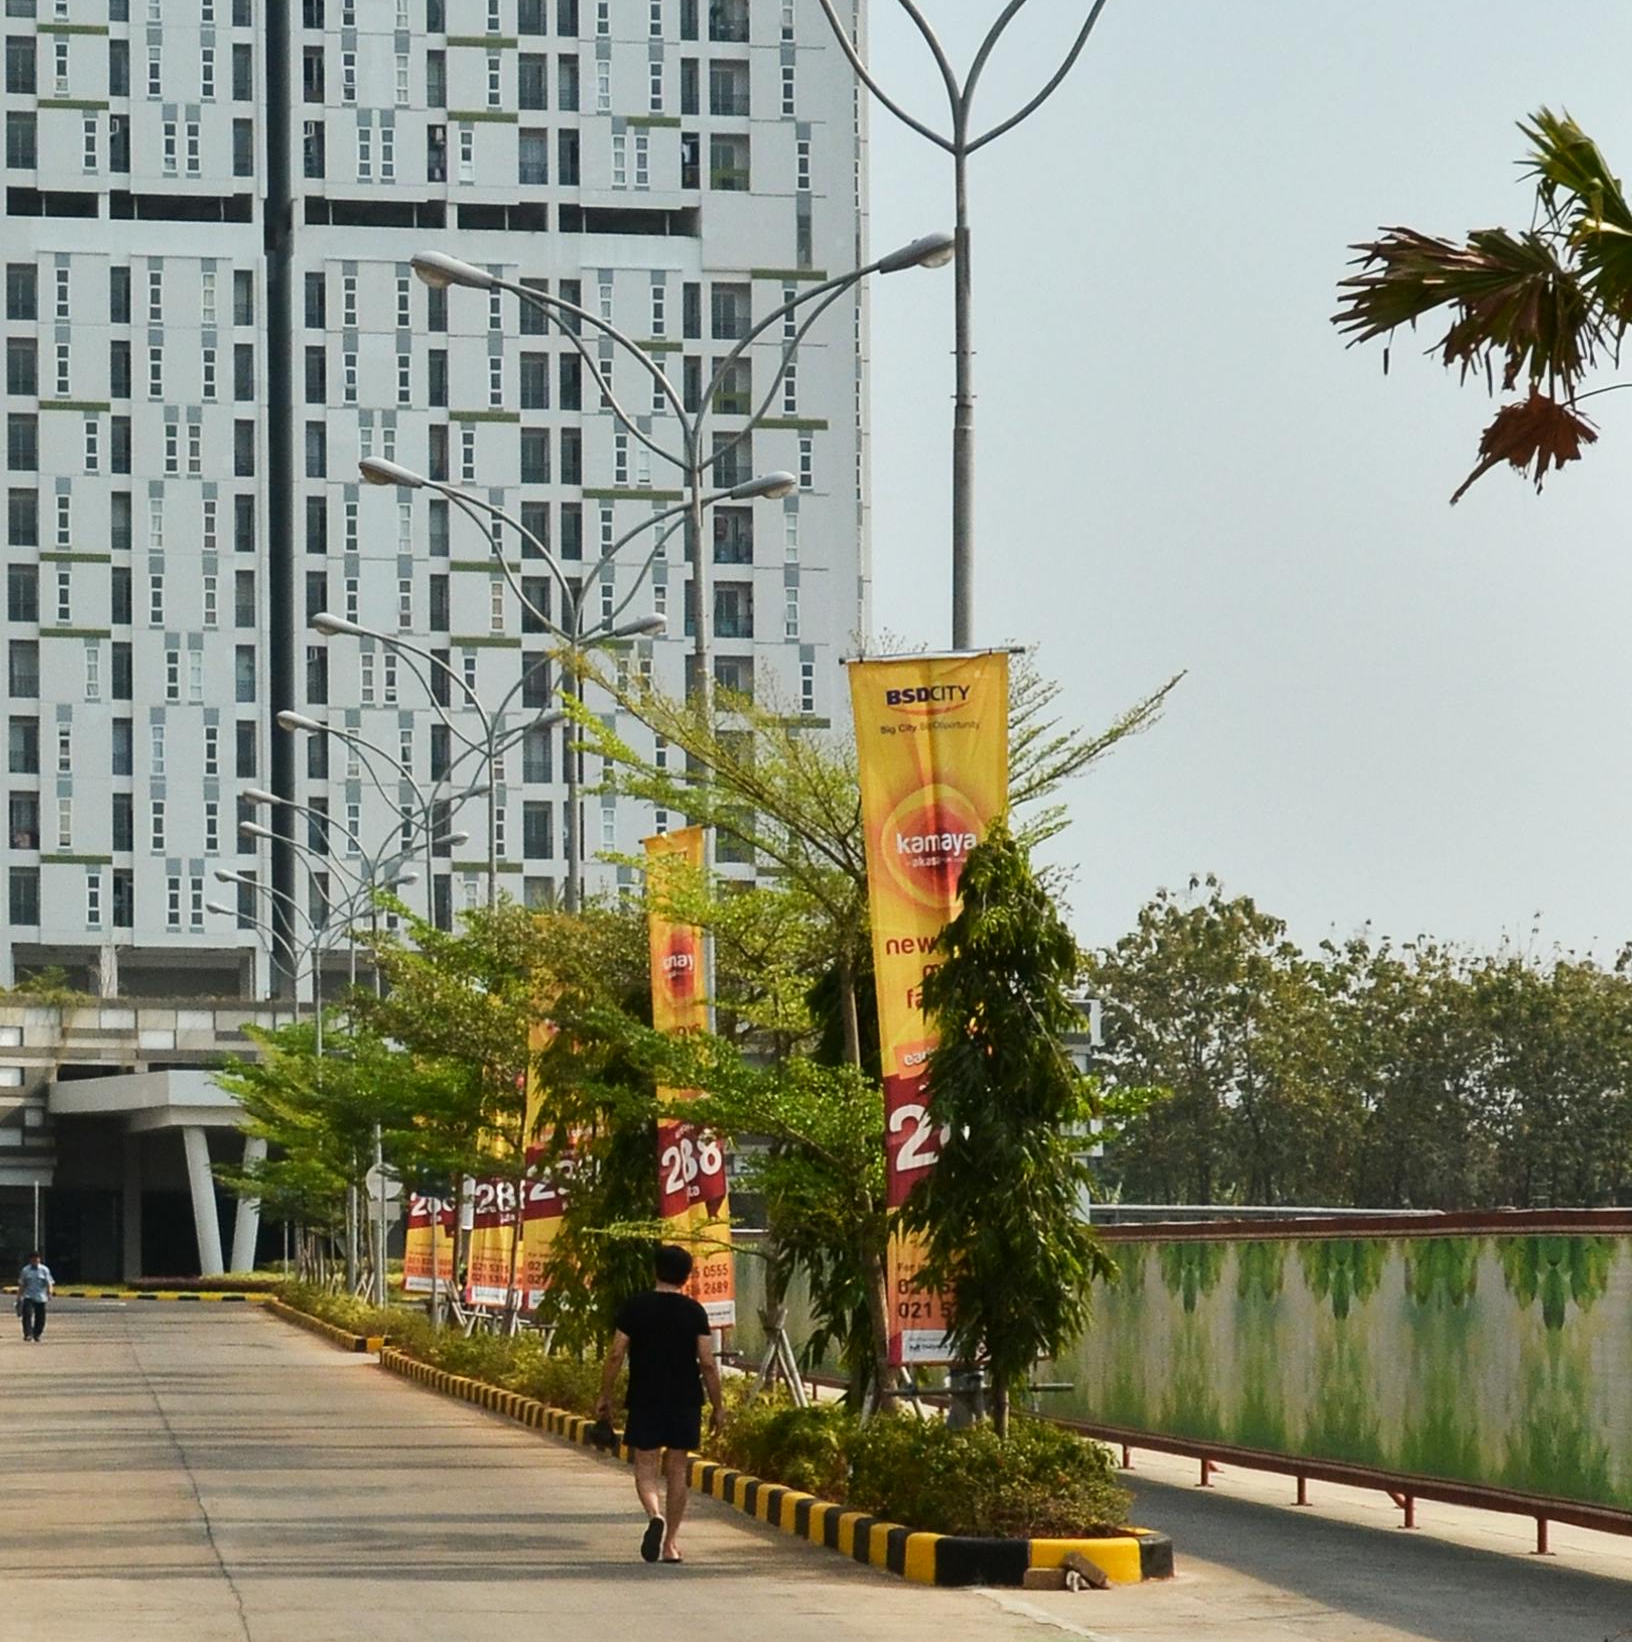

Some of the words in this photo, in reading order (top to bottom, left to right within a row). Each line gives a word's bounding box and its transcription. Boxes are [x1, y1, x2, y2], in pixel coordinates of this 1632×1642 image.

[885, 685, 970, 705] BSDCITY
[898, 723, 917, 733] City
[896, 833, 977, 856] kamaya
[661, 1134, 723, 1195] 288
[898, 1301, 931, 1318] 021
